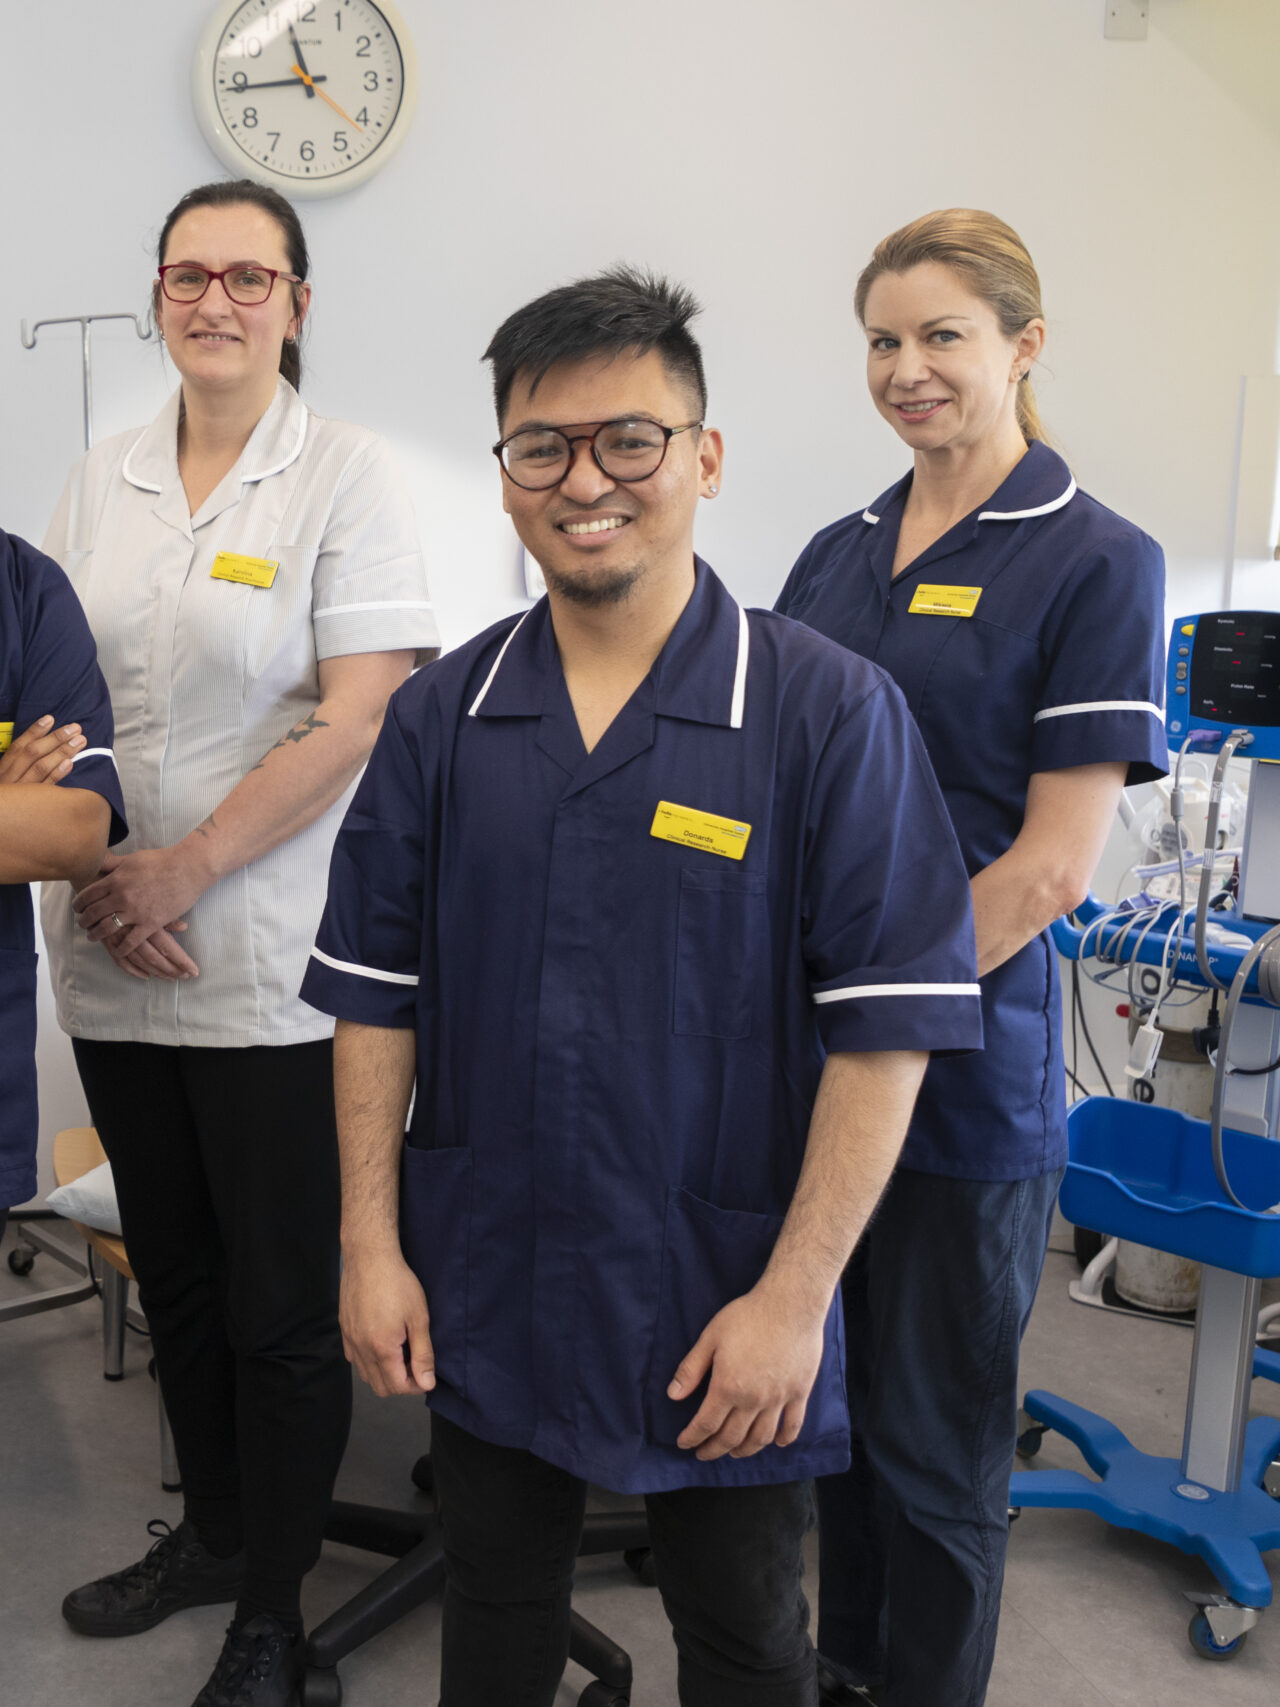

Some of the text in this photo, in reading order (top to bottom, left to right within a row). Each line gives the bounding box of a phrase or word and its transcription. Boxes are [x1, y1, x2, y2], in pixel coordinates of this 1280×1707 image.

[263, 10, 280, 32] 11
[295, 1, 316, 22] 12
[334, 9, 341, 32] 1
[241, 36, 262, 58] 10
[356, 36, 371, 57] 2
[232, 71, 248, 93] 9
[363, 71, 379, 92] 3
[243, 107, 258, 128] 8
[355, 106, 370, 126] 4
[266, 132, 281, 152] 7
[300, 140, 315, 161] 6
[333, 131, 348, 152] 5
